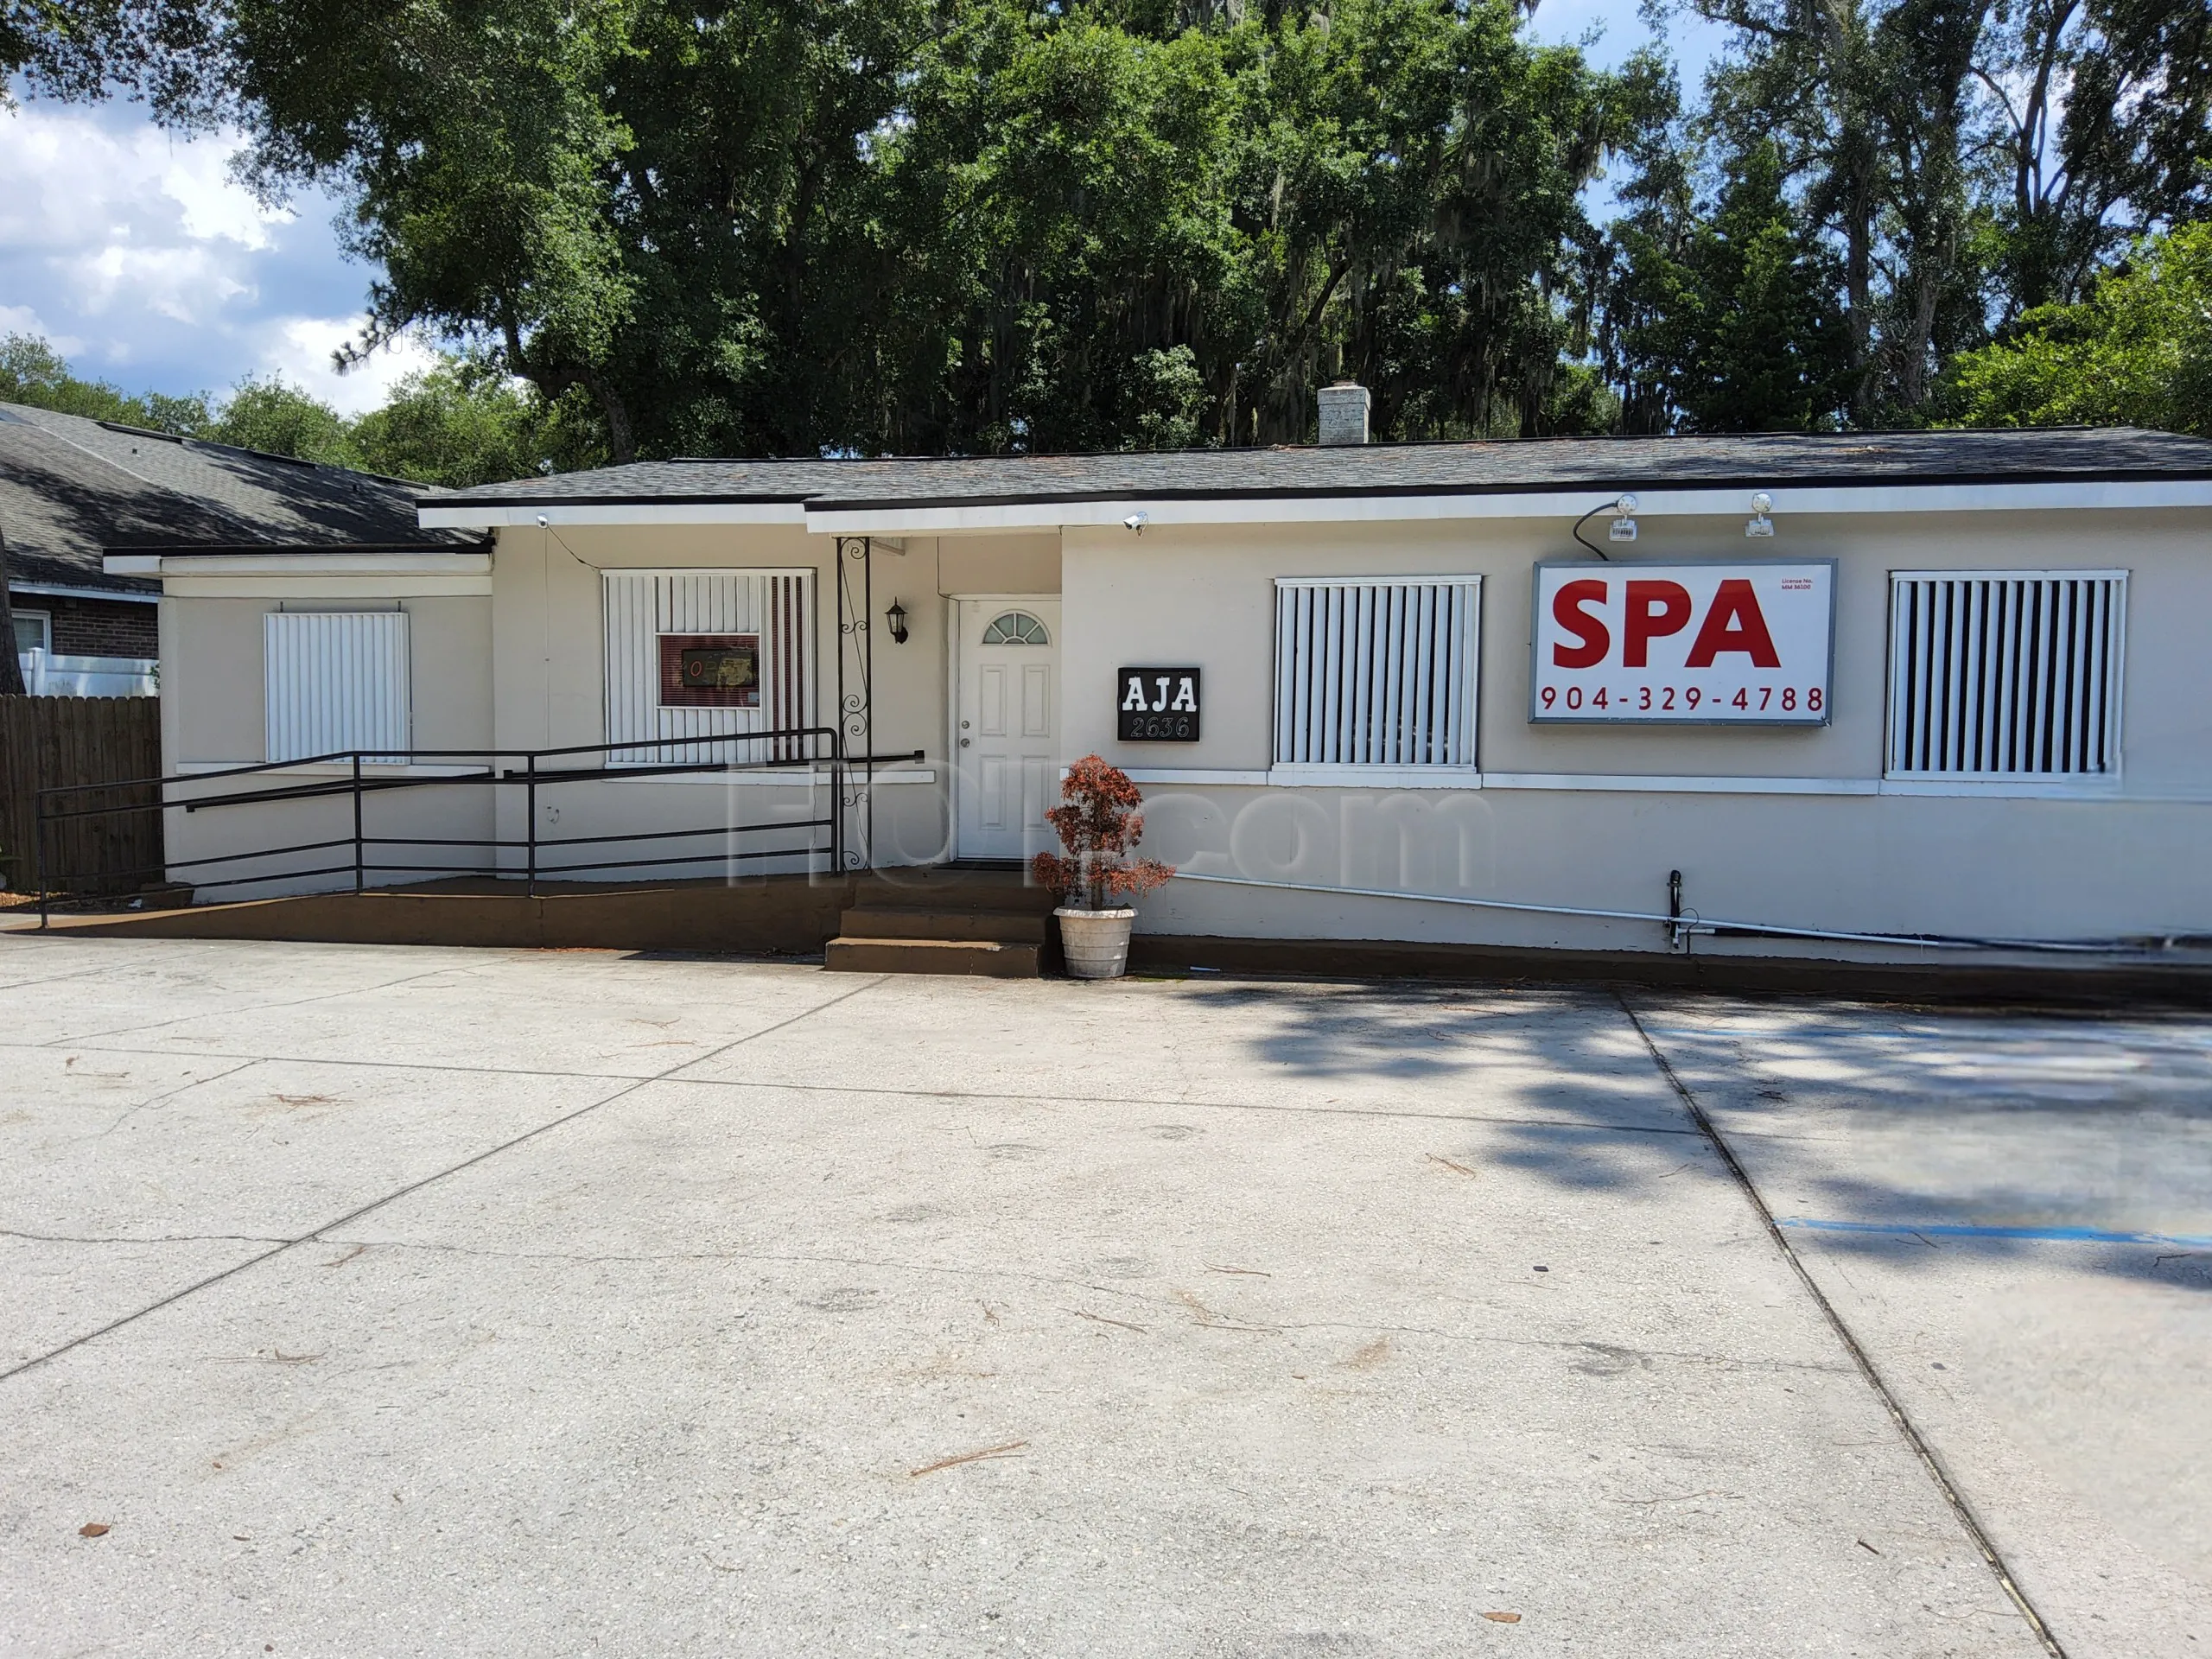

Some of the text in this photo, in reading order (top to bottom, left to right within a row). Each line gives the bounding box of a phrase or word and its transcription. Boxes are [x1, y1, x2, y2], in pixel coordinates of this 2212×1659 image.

[1553, 579, 1782, 669] SPA
[1122, 677, 1198, 712] AJA
[1541, 686, 1823, 711] 904-329-4788
[1130, 716, 1190, 738] 2636
